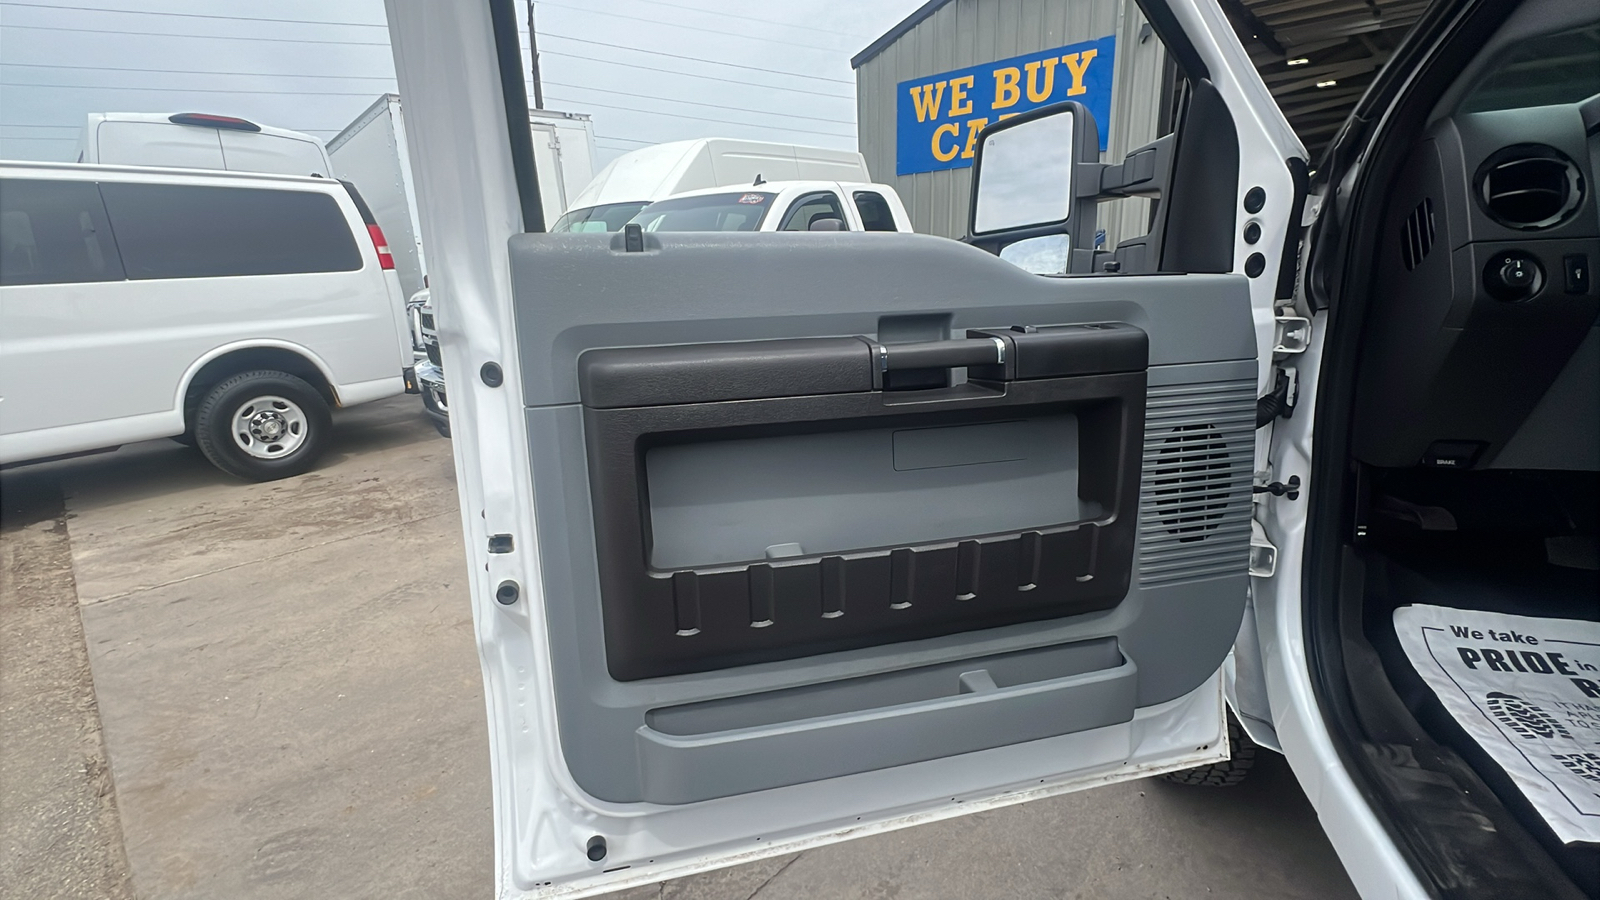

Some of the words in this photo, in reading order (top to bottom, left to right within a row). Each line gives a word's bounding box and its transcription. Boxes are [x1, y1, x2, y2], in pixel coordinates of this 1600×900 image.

[909, 75, 975, 122] WE
[991, 48, 1098, 110] BUY
[931, 112, 1021, 162] CA
[1449, 625, 1484, 640] We
[1488, 630, 1539, 646] take
[1456, 647, 1579, 676] PRIDE
[1574, 659, 1599, 672] in
